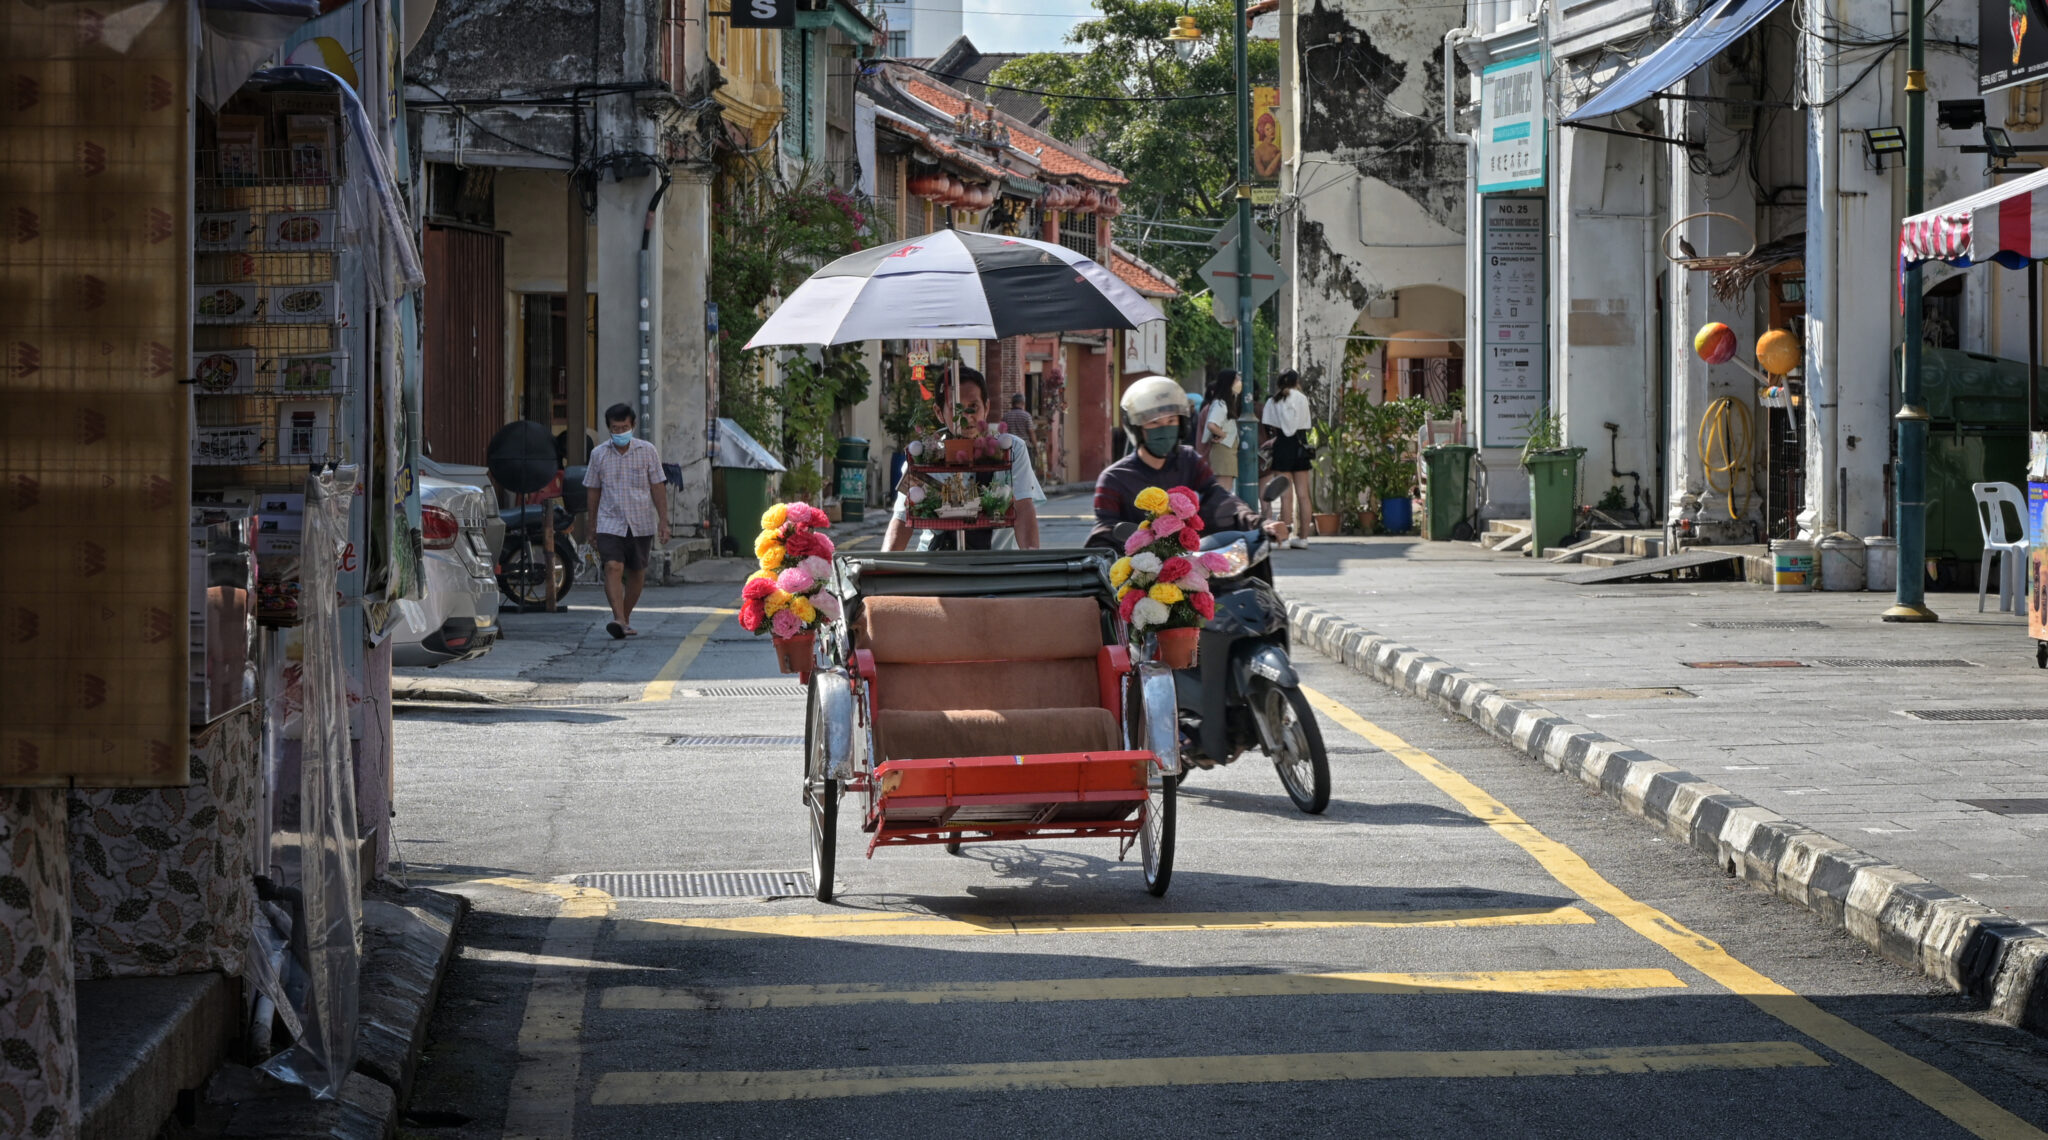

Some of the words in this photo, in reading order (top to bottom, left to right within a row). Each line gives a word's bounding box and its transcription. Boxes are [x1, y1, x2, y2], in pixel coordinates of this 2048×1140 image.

[1499, 205, 1515, 214] NO.
[1517, 205, 1528, 214] 25
[1491, 256, 1499, 266] G
[1494, 347, 1498, 358] 1
[1493, 394, 1499, 404] 2
